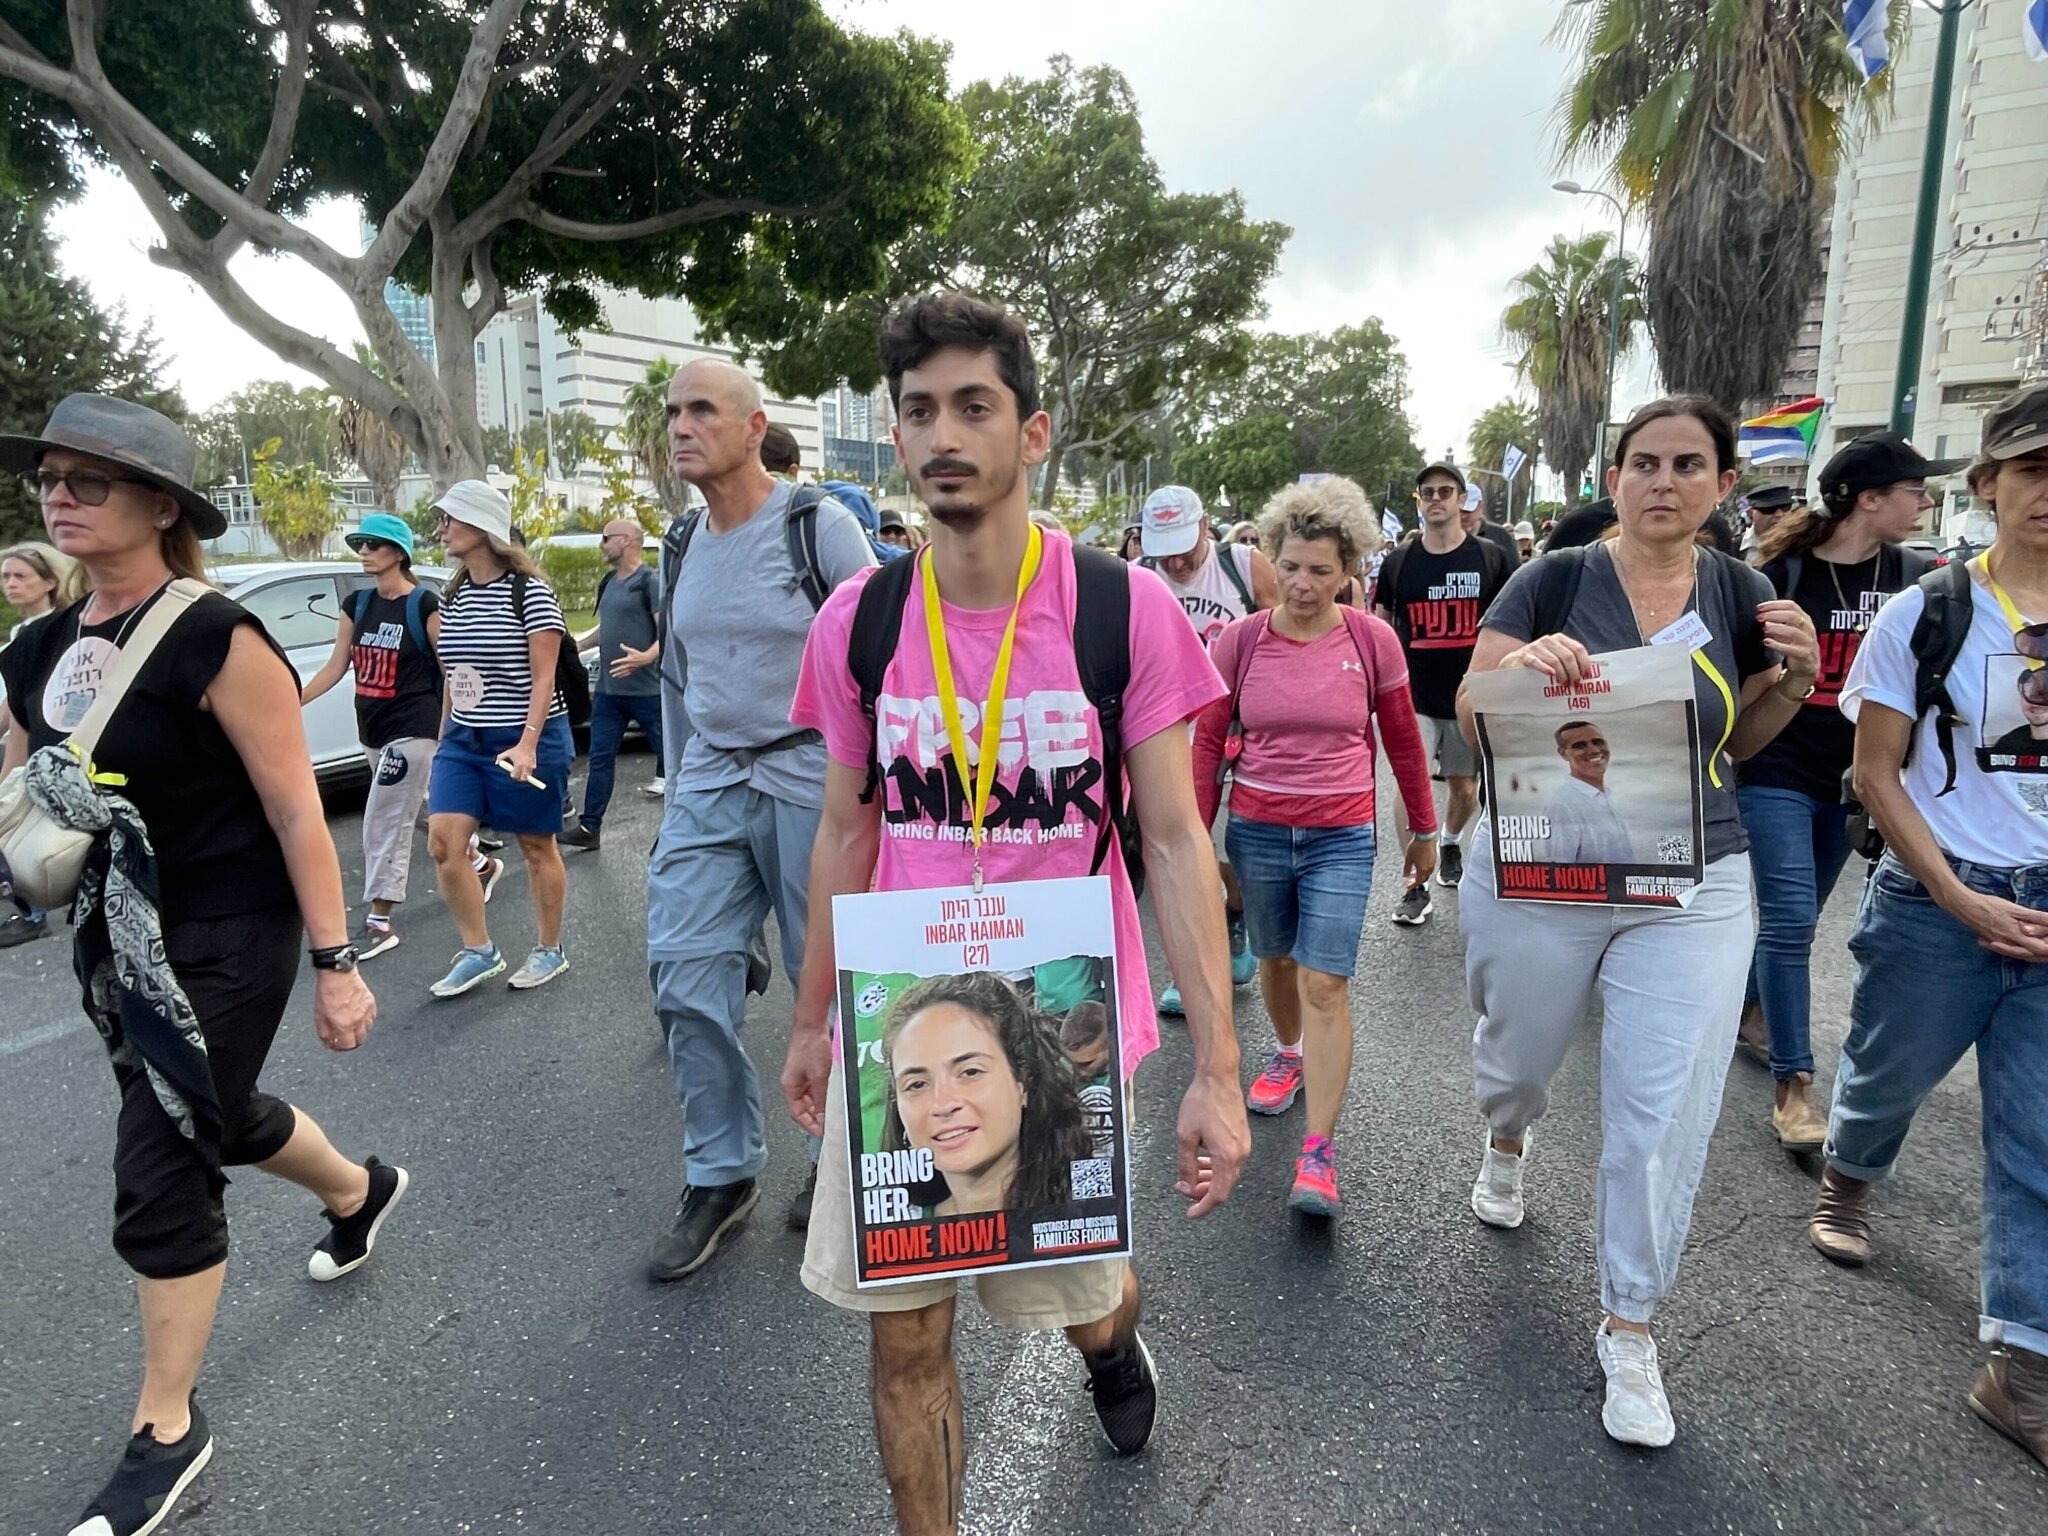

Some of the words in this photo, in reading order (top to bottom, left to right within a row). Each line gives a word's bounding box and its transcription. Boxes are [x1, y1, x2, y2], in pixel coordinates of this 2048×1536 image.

[1428, 586, 1457, 600] הביתה
[1573, 680, 1611, 696] MIRAN
[1567, 697, 1590, 711] (46)
[876, 690, 1090, 768] FREE
[938, 825, 988, 843] INBAR
[991, 828, 1033, 844] BACK
[1037, 823, 1084, 844] HOME
[1498, 815, 1551, 840] BRING
[1500, 840, 1533, 863] HIM
[1503, 866, 1550, 887] HOME
[1555, 864, 1607, 892] NOW!
[1626, 883, 1663, 897] FAMILIES
[940, 899, 970, 922] הימן
[973, 896, 1006, 917] ענבר
[925, 923, 966, 944] INBAR
[970, 918, 1024, 941] HAIMAN
[963, 943, 989, 967] (27)
[860, 1147, 934, 1187] BRING
[863, 1188, 911, 1225] HER
[1032, 1219, 1069, 1234] HOSTAGES
[1069, 1217, 1085, 1230] AND
[865, 1225, 934, 1264] HOME
[939, 1212, 1007, 1256] NOW!
[1033, 1229, 1080, 1250] FAMILIES
[1081, 1226, 1119, 1245] FORUM
